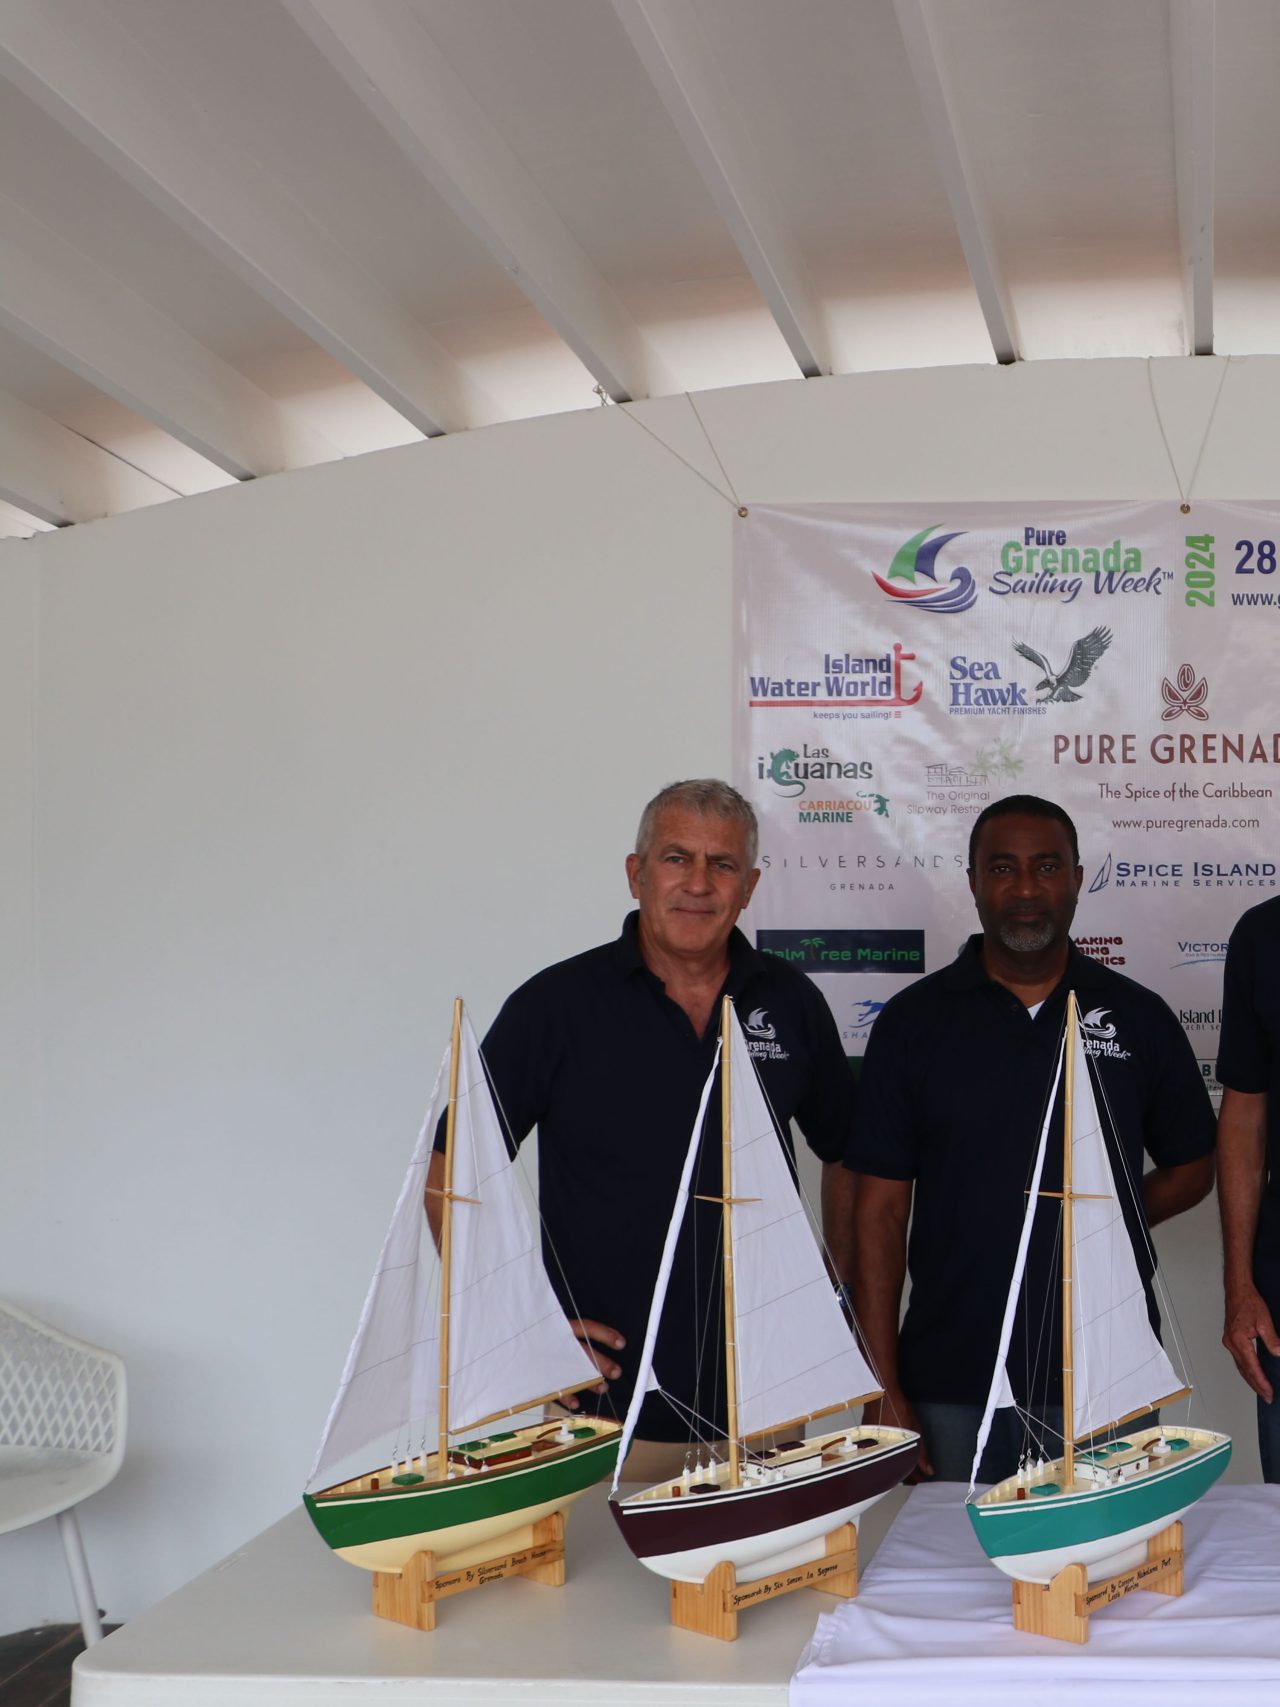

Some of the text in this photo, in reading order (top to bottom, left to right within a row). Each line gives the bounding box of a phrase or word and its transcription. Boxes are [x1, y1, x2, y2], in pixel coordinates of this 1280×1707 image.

[1024, 527, 1067, 546] Pure
[1000, 540, 1142, 574] Grenada
[1234, 539, 1277, 575] 28
[1184, 533, 1216, 608] 2024
[988, 569, 1083, 603] Sailing
[824, 653, 891, 675] Island
[949, 656, 1001, 681] Sea
[750, 676, 892, 698] Water World
[949, 682, 1028, 707] Hawk
[812, 709, 892, 721] keeps you sailing!
[949, 706, 1047, 716] PREMIUM YACHT FINISHES
[803, 744, 830, 760] Las
[1053, 735, 1137, 765] PURE
[927, 790, 990, 803] The Original
[1098, 782, 1273, 804] The Spice of the Caribbean
[799, 800, 871, 811] CARRIACOU
[907, 803, 948, 816] Slipway
[799, 811, 853, 823] MARINE
[1112, 815, 1260, 833] www.puregrenada.com
[761, 855, 964, 868] SILVERSANDS
[1116, 861, 1277, 878] SPICE ISLAND
[830, 883, 895, 891] GRENADA
[1116, 879, 1277, 888] MARINE SERVICES
[857, 948, 921, 961] Marine
[1179, 1009, 1215, 1024] Island
[1184, 1023, 1205, 1031] acht
[747, 1040, 782, 1052] renada
[1081, 1039, 1120, 1051] renada
